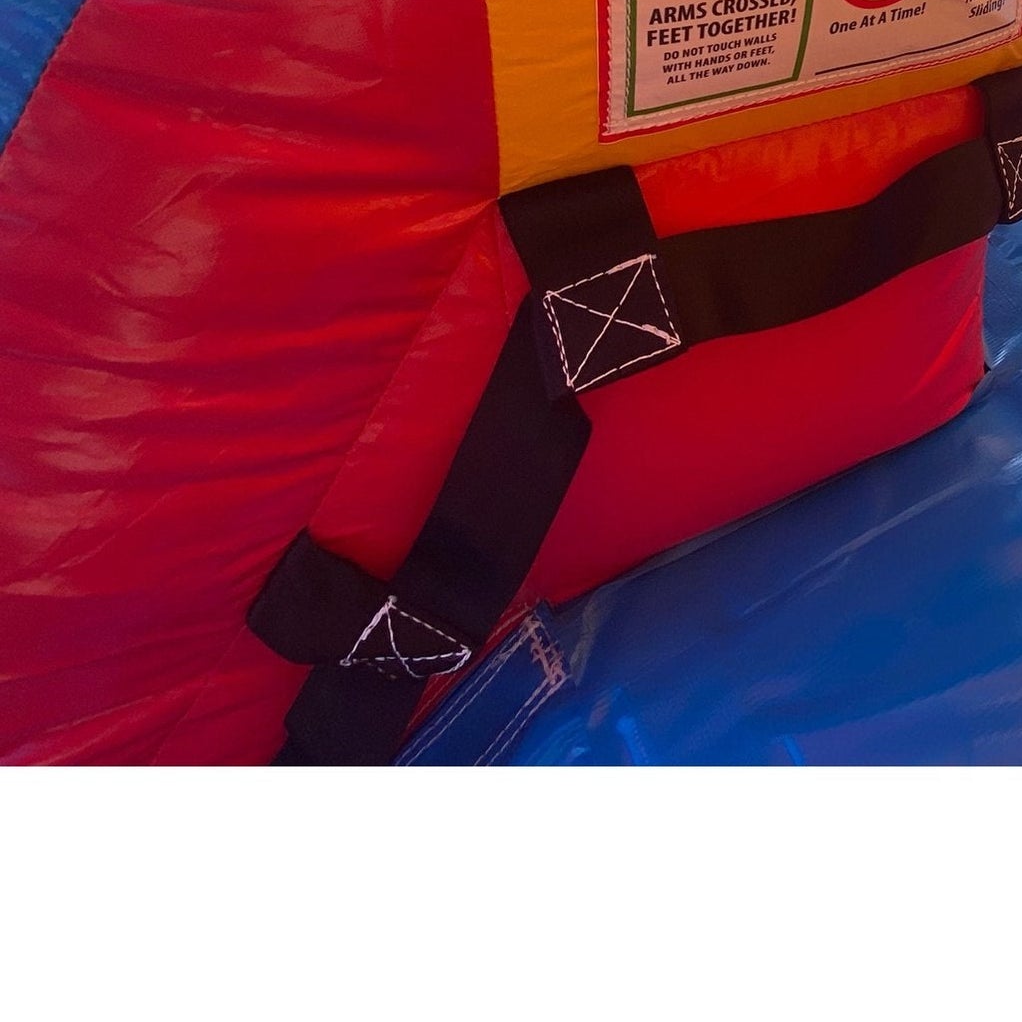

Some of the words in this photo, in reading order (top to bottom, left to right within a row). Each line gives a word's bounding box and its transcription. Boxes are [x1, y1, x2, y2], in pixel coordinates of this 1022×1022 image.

[649, 2, 707, 25] ARMS
[829, 21, 857, 34] One
[860, 15, 876, 28] At
[877, 14, 887, 25] A
[890, 2, 926, 22] Time!
[647, 26, 693, 47] FEET
[697, 8, 797, 39] TOGETHER!
[662, 60, 692, 73] WITH
[695, 55, 731, 68] HANDS
[734, 52, 747, 60] OR
[750, 46, 775, 57] FEET,
[664, 51, 679, 61] DO
[682, 46, 704, 58] NOT
[707, 40, 741, 53] TOUCH
[744, 33, 777, 46] WALLS
[667, 71, 686, 85] ALL
[689, 69, 710, 80] THE
[712, 64, 735, 76] WAY
[736, 58, 771, 71] DOWN.
